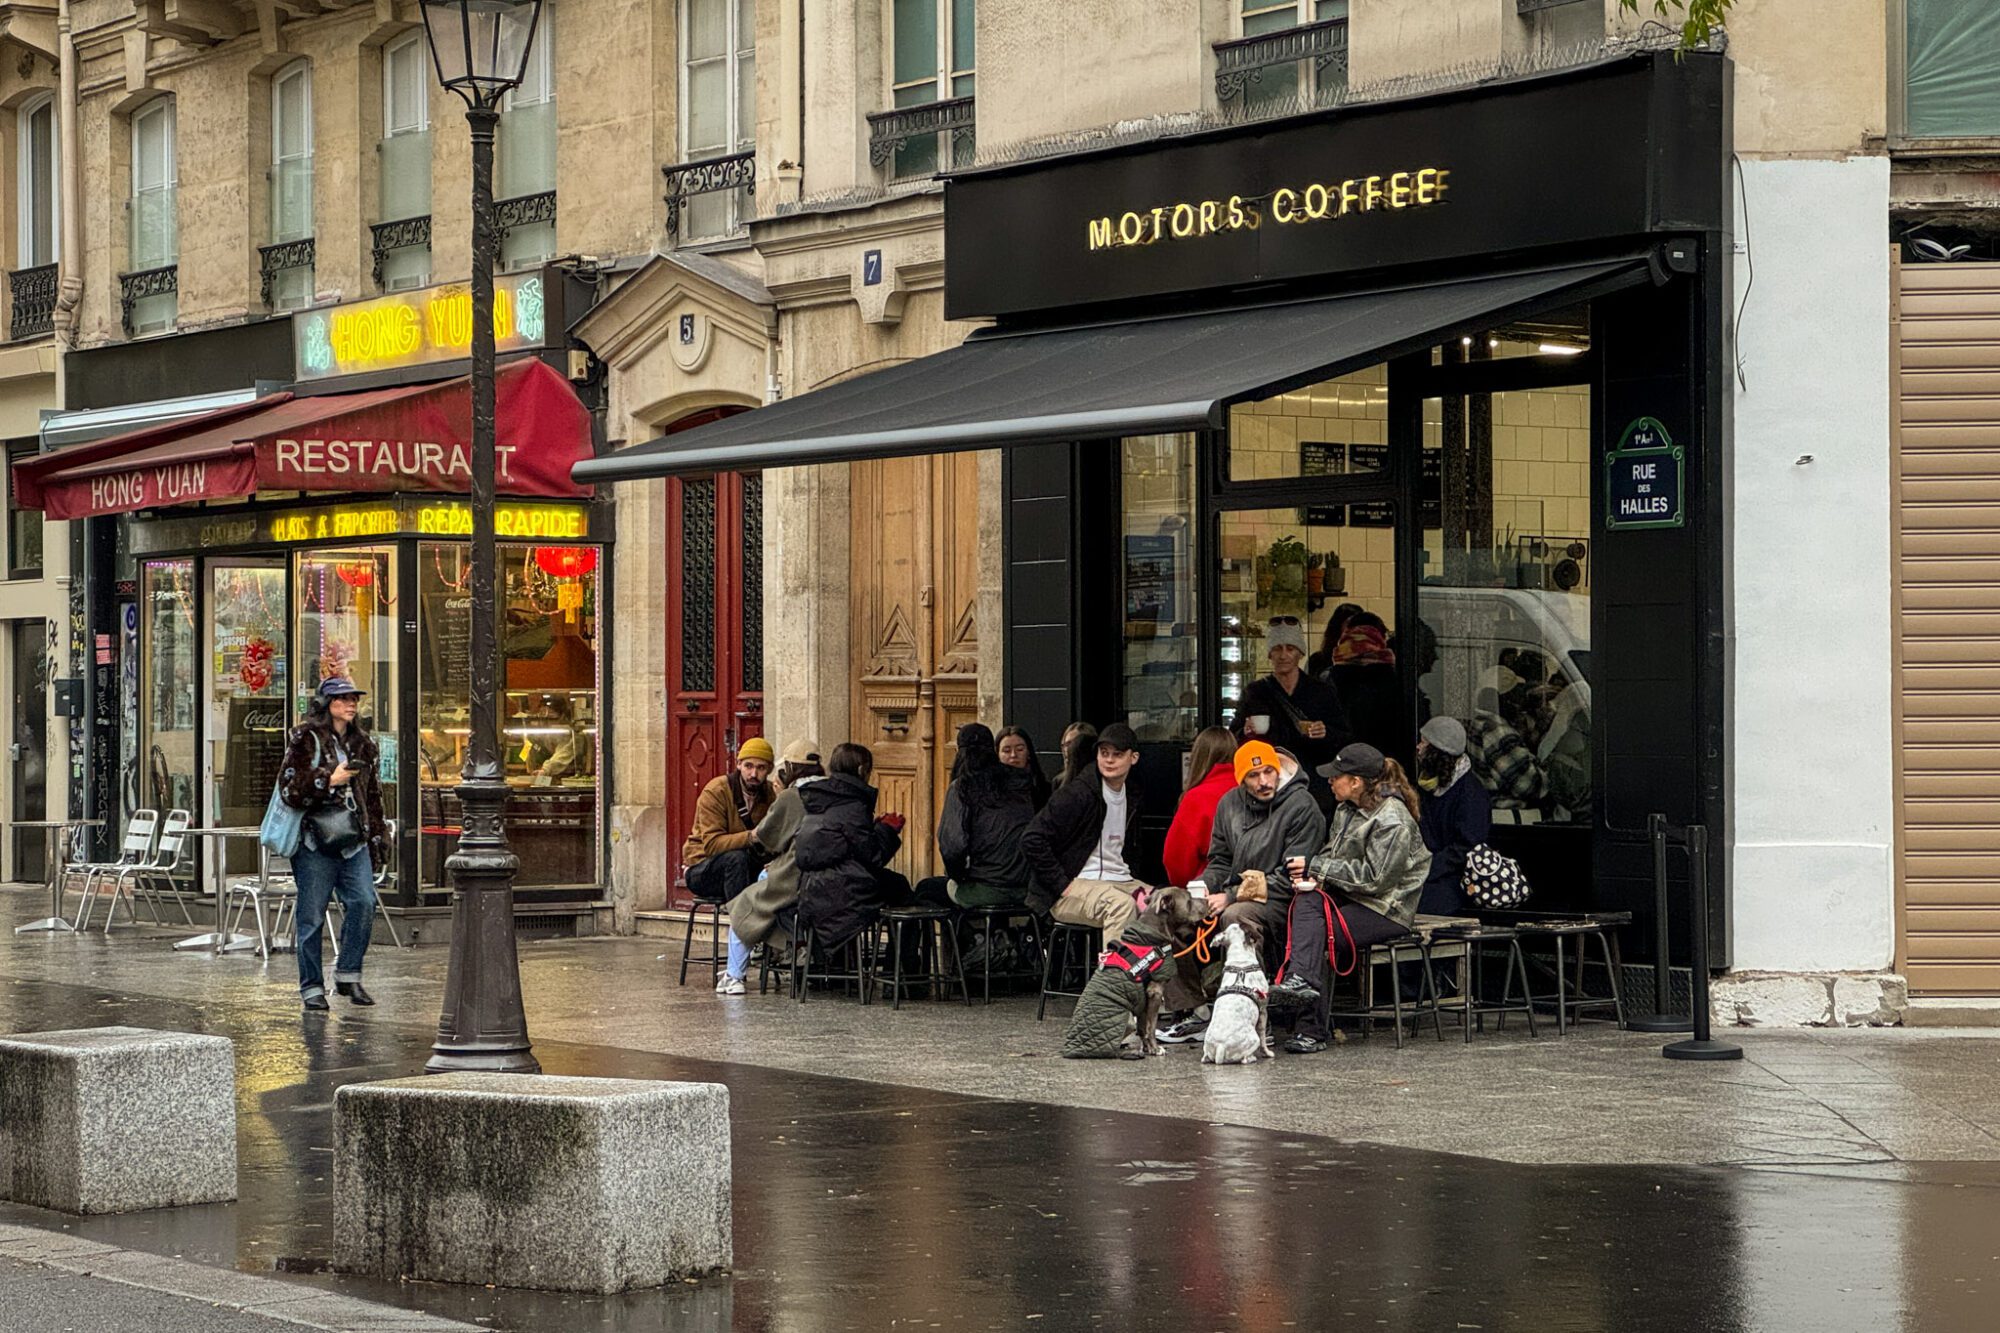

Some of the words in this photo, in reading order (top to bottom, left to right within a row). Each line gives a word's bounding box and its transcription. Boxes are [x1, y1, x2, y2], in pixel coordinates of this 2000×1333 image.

[1088, 195, 1243, 250] MOTORS
[1272, 168, 1437, 223] COFFEE
[867, 255, 877, 281] 7
[334, 305, 418, 361] HONG
[430, 289, 507, 347] YUN
[683, 317, 693, 341] 5
[275, 439, 516, 477] RESTAURAT
[1632, 463, 1656, 480] RUE
[91, 471, 143, 509] HONG
[155, 462, 206, 499] YUAN
[1637, 484, 1651, 493] DES
[1620, 497, 1668, 515] HALLES
[420, 507, 484, 534] REPA
[499, 510, 580, 537] RAPIDE
